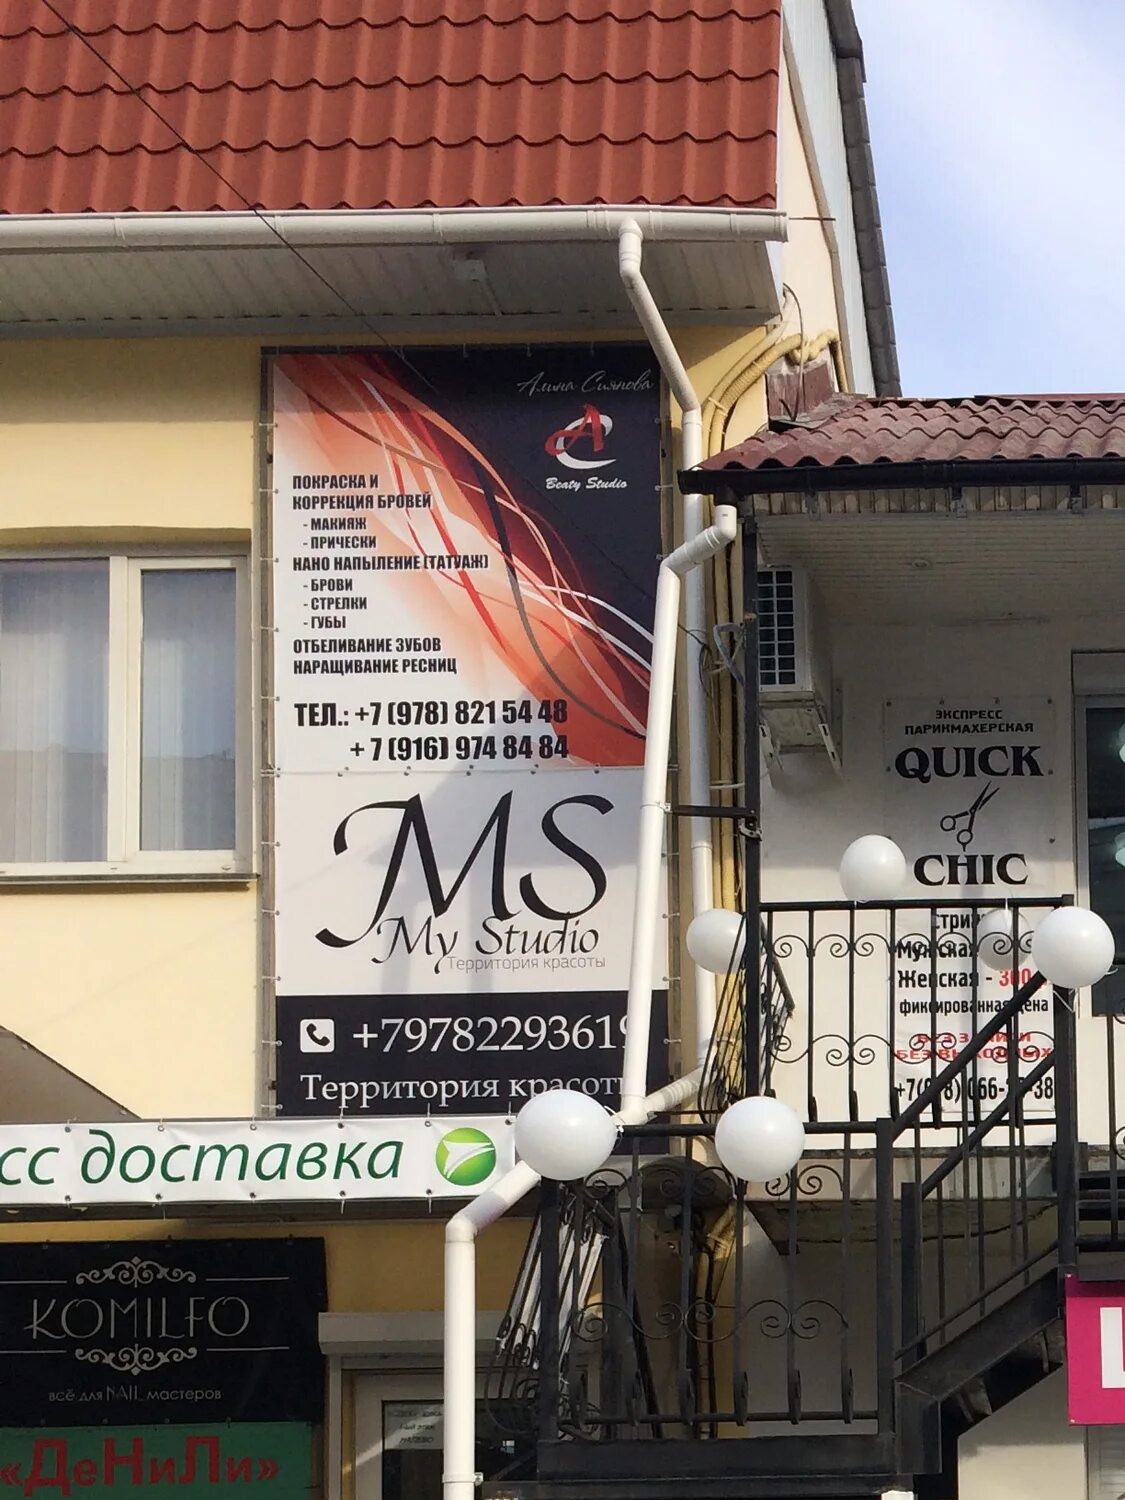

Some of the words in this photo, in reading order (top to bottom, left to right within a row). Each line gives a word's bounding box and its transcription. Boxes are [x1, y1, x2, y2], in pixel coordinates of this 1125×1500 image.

[293, 475, 367, 489] ПОКРАСКА
[369, 475, 379, 488] И
[545, 477, 581, 492] Beaty
[585, 476, 627, 489] Studio
[293, 495, 374, 511] КОРРЕКЦИЯ
[377, 491, 431, 509] БРОВЕЙ
[311, 517, 367, 530] МАКИЯЖ
[311, 535, 377, 549] ПРИЧЕСКИ
[293, 556, 330, 571] НАНО
[334, 555, 420, 570] НАПЫЛЕНИЕ
[424, 554, 489, 570] (ТАТУАЖ)
[311, 578, 353, 592] БРОВИ
[311, 596, 367, 610] СТРЕЛКИ
[311, 616, 346, 629] ГУБЫ
[293, 638, 392, 654] ОТБЕЛИВАНИЕ
[395, 637, 441, 652] ЗУБОВ
[293, 658, 399, 676] НАРАЩИВАНИЕ
[402, 657, 457, 674] РЕСНИЦ
[294, 702, 349, 727] ТЕЛ.:
[355, 702, 382, 726] +7
[388, 701, 448, 726] (978)
[455, 700, 496, 725] 821
[502, 700, 532, 724] 54
[538, 699, 567, 723] 48
[935, 709, 1003, 720] ЭКСПРЕСС
[905, 722, 1034, 736] ПАРИКМАХЕРСКАЯ
[370, 737, 382, 761] 7
[388, 736, 449, 761] (916)
[455, 736, 497, 760] 974
[503, 735, 533, 759] 84
[538, 735, 569, 758] 84
[895, 745, 1044, 784] QUICK
[315, 790, 614, 948] MS
[914, 853, 1029, 886] CHIC
[372, 915, 458, 974] My
[476, 913, 600, 955] Studio
[449, 956, 539, 973] Территория
[543, 955, 606, 972] красоты
[897, 970, 979, 988] Жеская
[899, 999, 1011, 1016] фикировнна
[1016, 999, 1049, 1015] ена
[897, 1049, 932, 1060] БЕЗ
[939, 1048, 1052, 1060] ВОДЫХ
[300, 1074, 499, 1109] Территория
[509, 1077, 623, 1099] красот
[81, 1128, 404, 1185] доставка
[23, 1295, 250, 1340] KOMILFO
[48, 1388, 75, 1402] всё
[79, 1391, 103, 1402] для
[106, 1385, 144, 1402] NAIL
[147, 1388, 222, 1403] мастеров
[0, 1436, 279, 1497] «ДеНиЛи»
